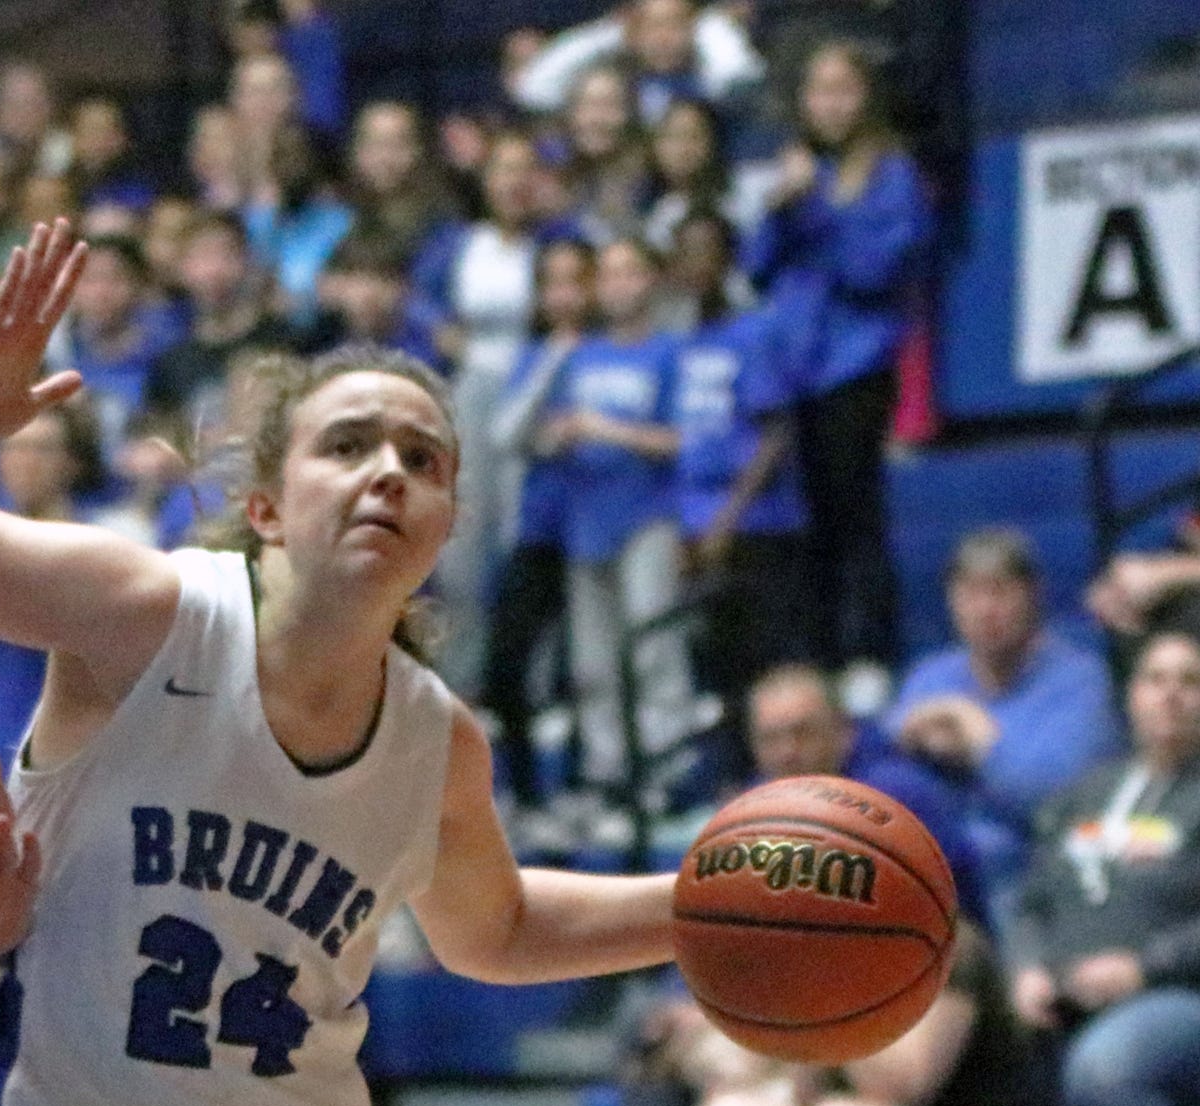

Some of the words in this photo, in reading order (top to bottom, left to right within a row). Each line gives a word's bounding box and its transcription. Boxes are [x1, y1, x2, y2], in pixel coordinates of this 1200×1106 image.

[1058, 206, 1174, 350] A
[131, 806, 376, 959] BRUINS
[695, 840, 877, 904] Wilson
[125, 913, 314, 1078] 24
